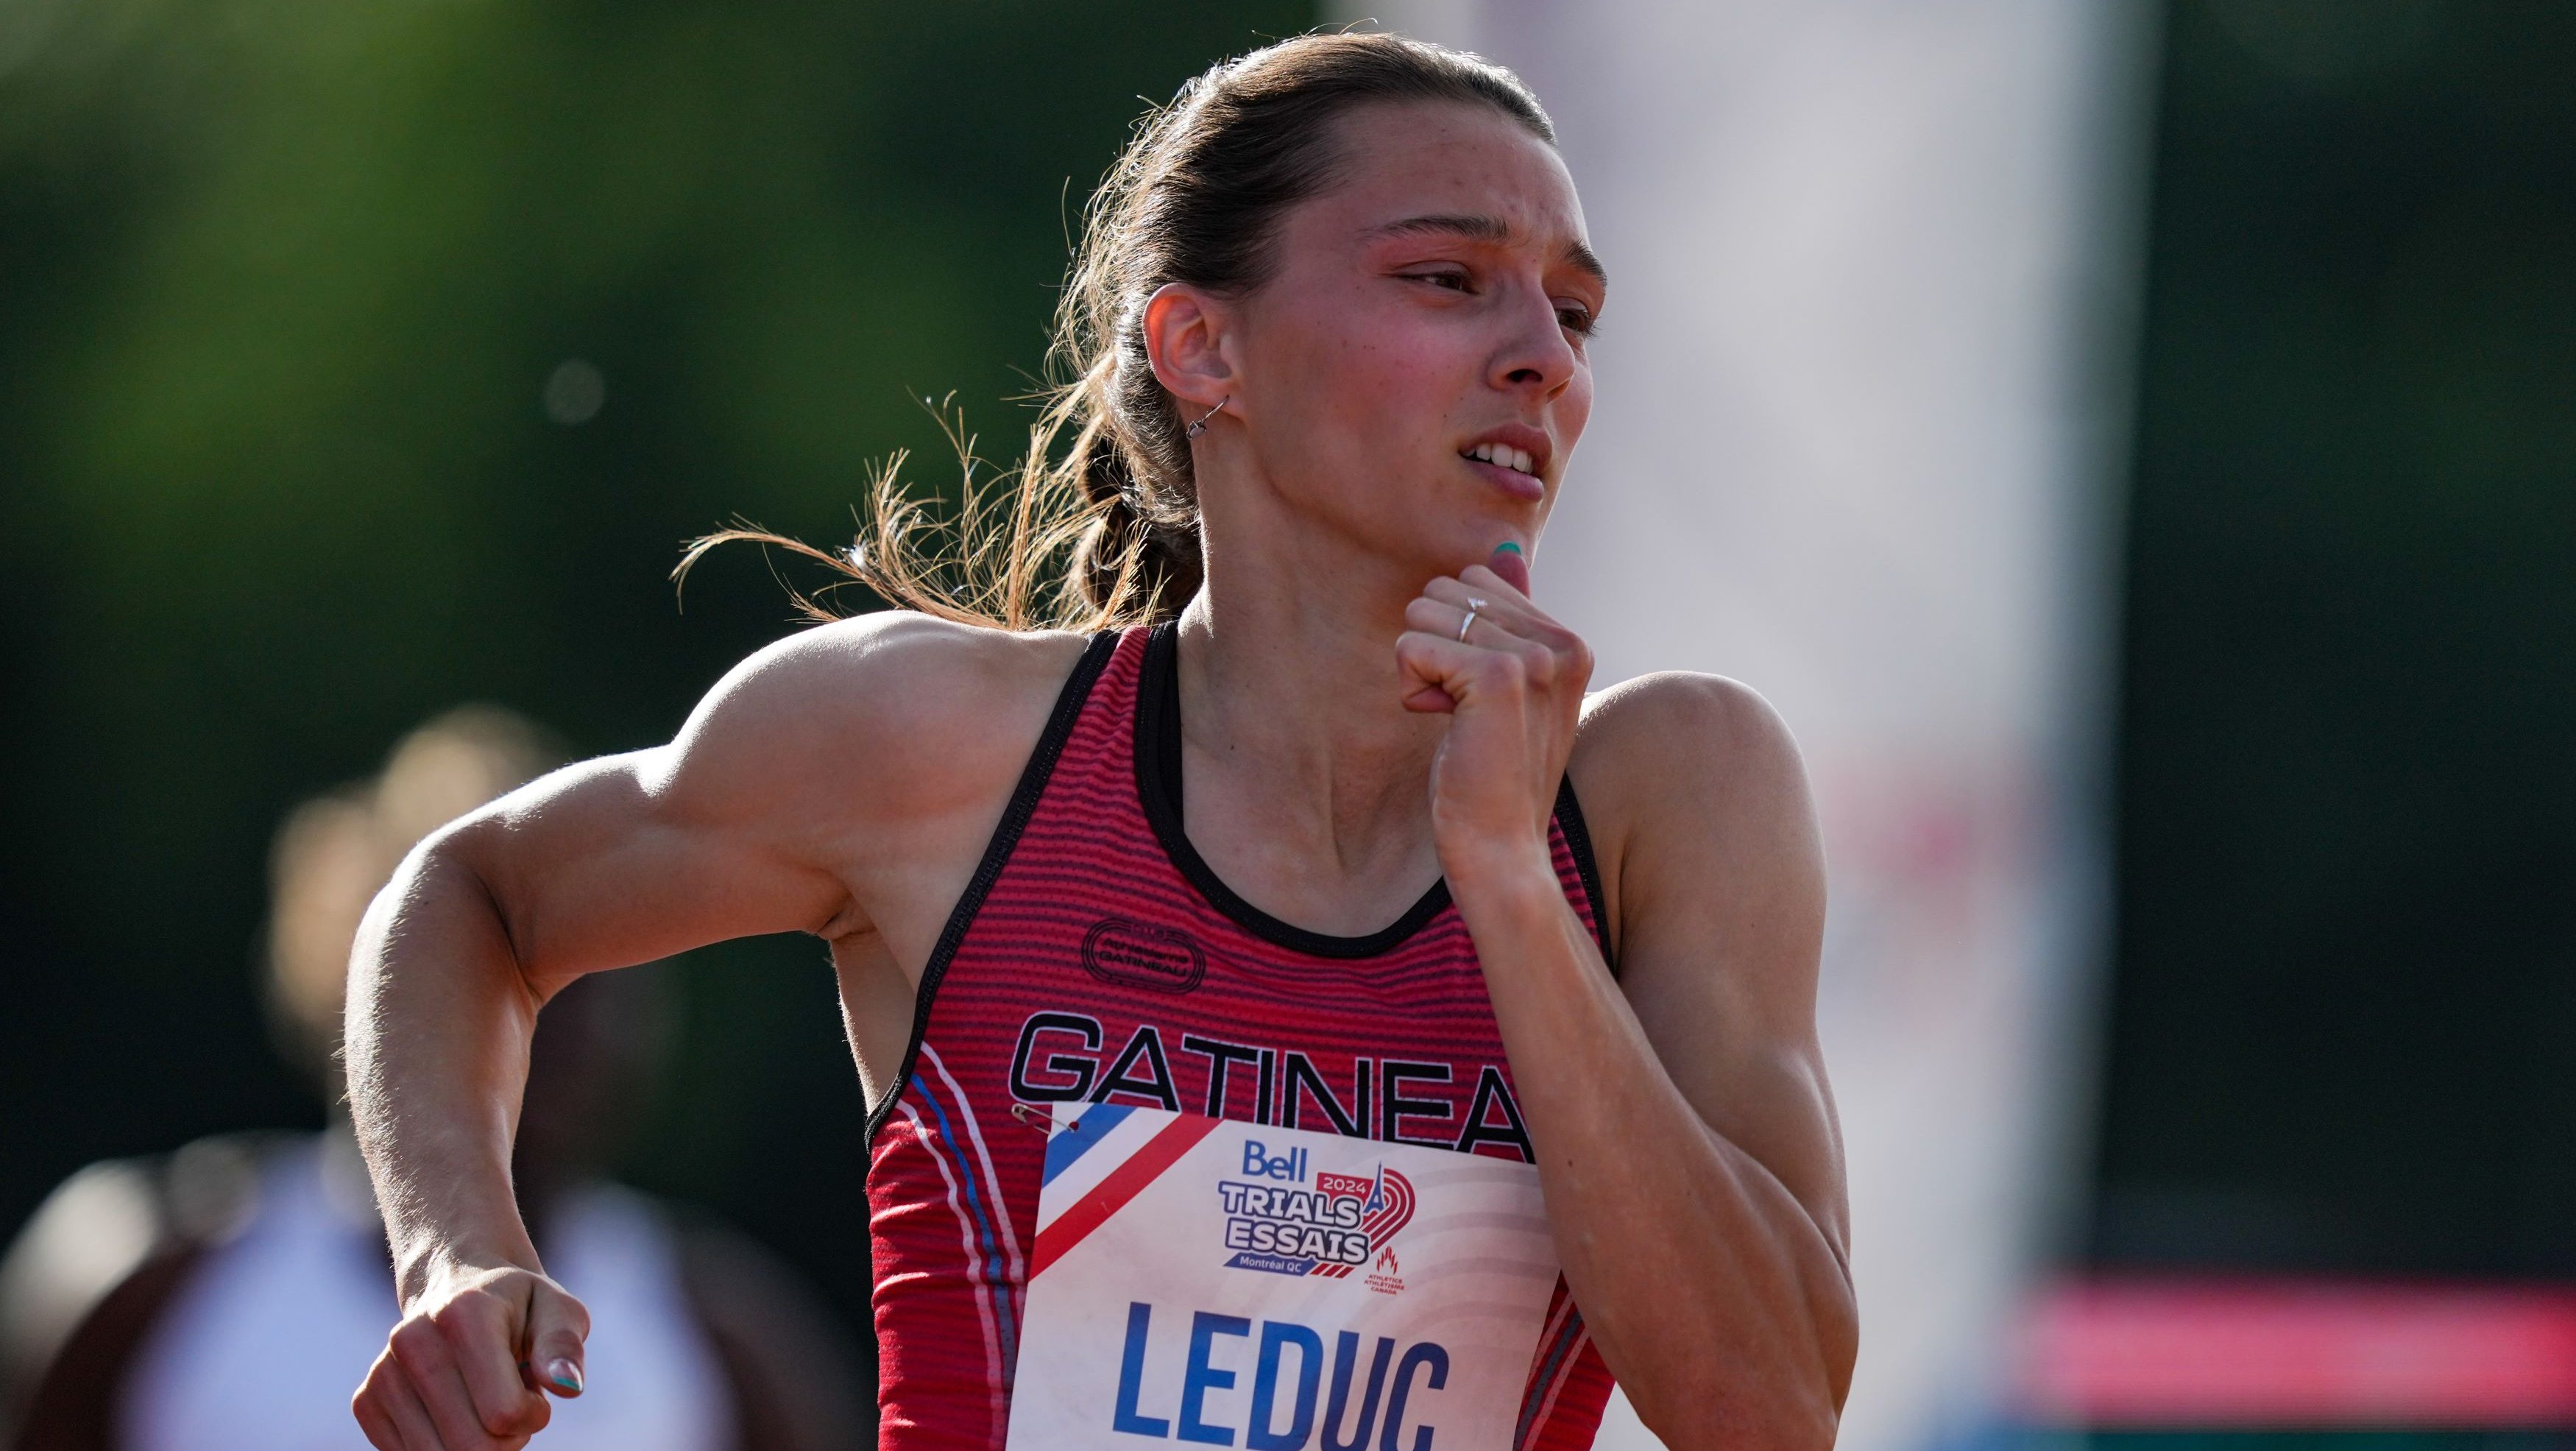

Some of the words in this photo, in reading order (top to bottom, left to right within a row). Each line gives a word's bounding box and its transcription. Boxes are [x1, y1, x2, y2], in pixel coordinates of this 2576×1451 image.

[1242, 1140, 1308, 1183] Bell
[1219, 1181, 1362, 1229] TRIALS
[1323, 1176, 1367, 1195] 2024
[1225, 1218, 1369, 1265] ESSAIS
[1239, 1256, 1285, 1271] Montréal
[1287, 1261, 1302, 1273] QC
[1370, 1287, 1397, 1296] CANADA
[1112, 1301, 1450, 1451] LEDUC
